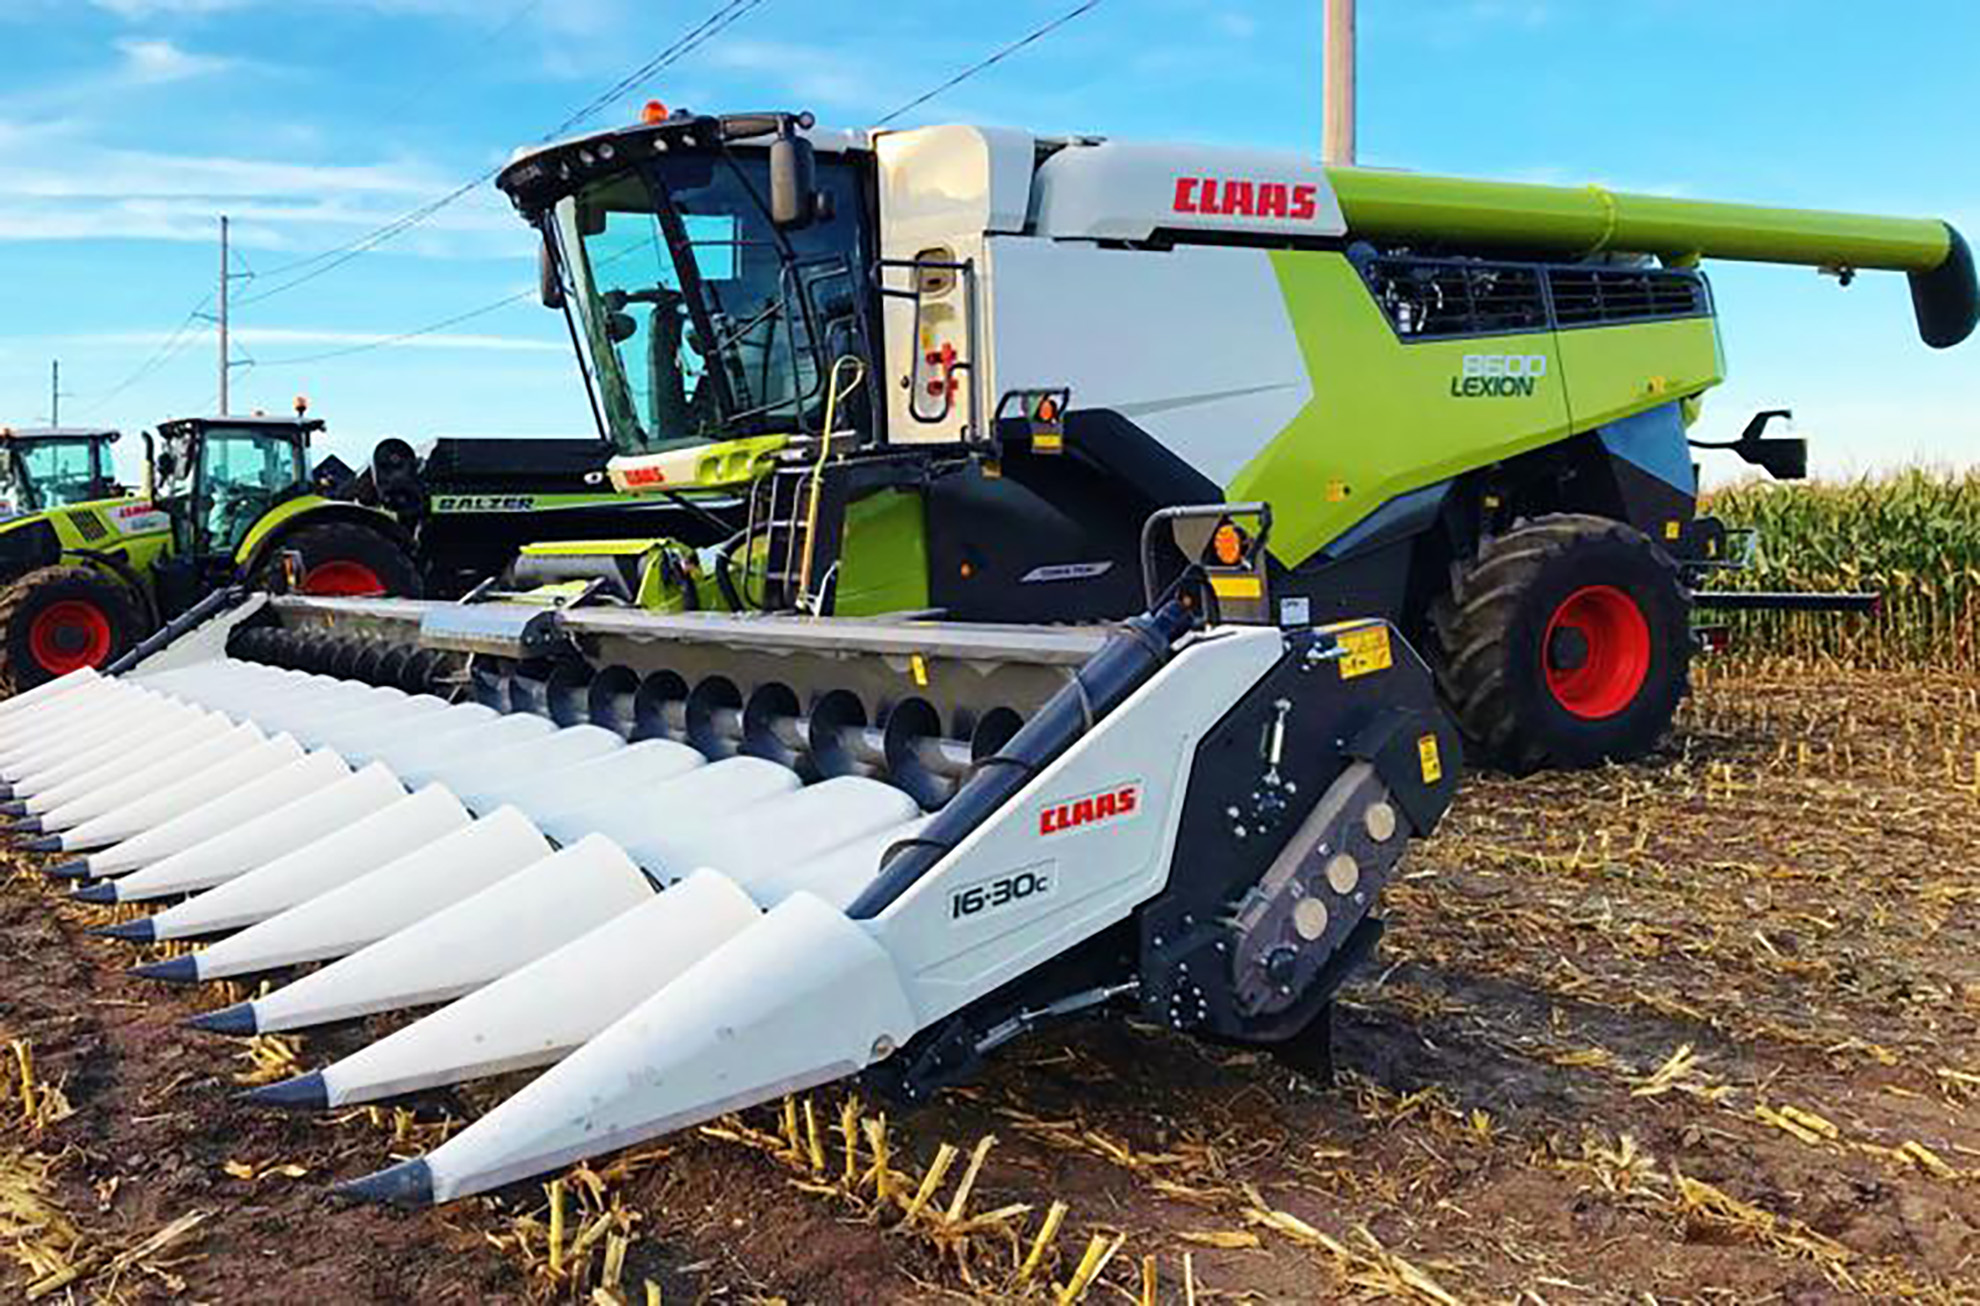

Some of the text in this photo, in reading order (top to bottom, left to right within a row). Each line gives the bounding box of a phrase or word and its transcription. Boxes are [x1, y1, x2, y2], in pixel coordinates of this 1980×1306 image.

[1173, 177, 1317, 219] CLAAS
[1462, 355, 1546, 376] 8600
[1451, 376, 1534, 397] LEXION
[438, 498, 535, 510] BALZER
[1039, 788, 1136, 835] CLAAS
